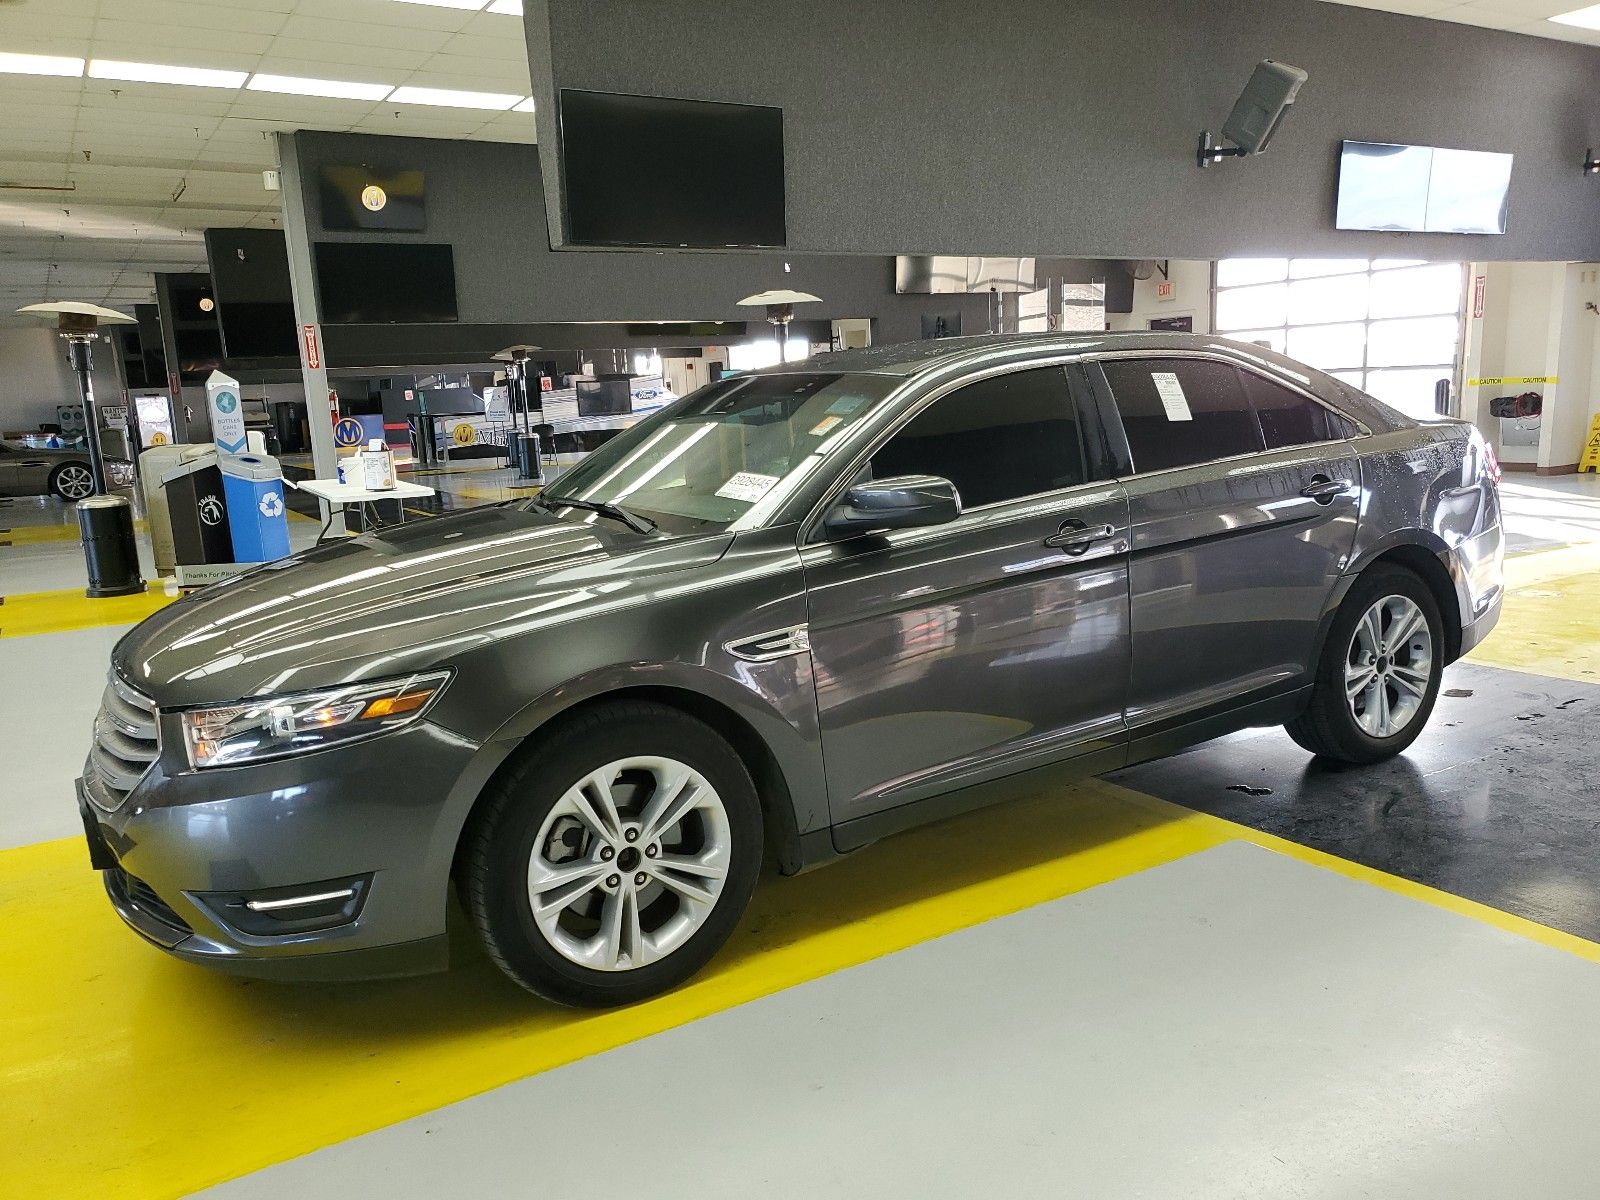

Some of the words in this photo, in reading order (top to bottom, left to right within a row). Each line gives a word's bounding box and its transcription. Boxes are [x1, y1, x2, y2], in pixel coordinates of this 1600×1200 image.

[1158, 283, 1170, 296] EXIT
[217, 417, 240, 425] BOTTLES
[198, 494, 216, 507] TRASH
